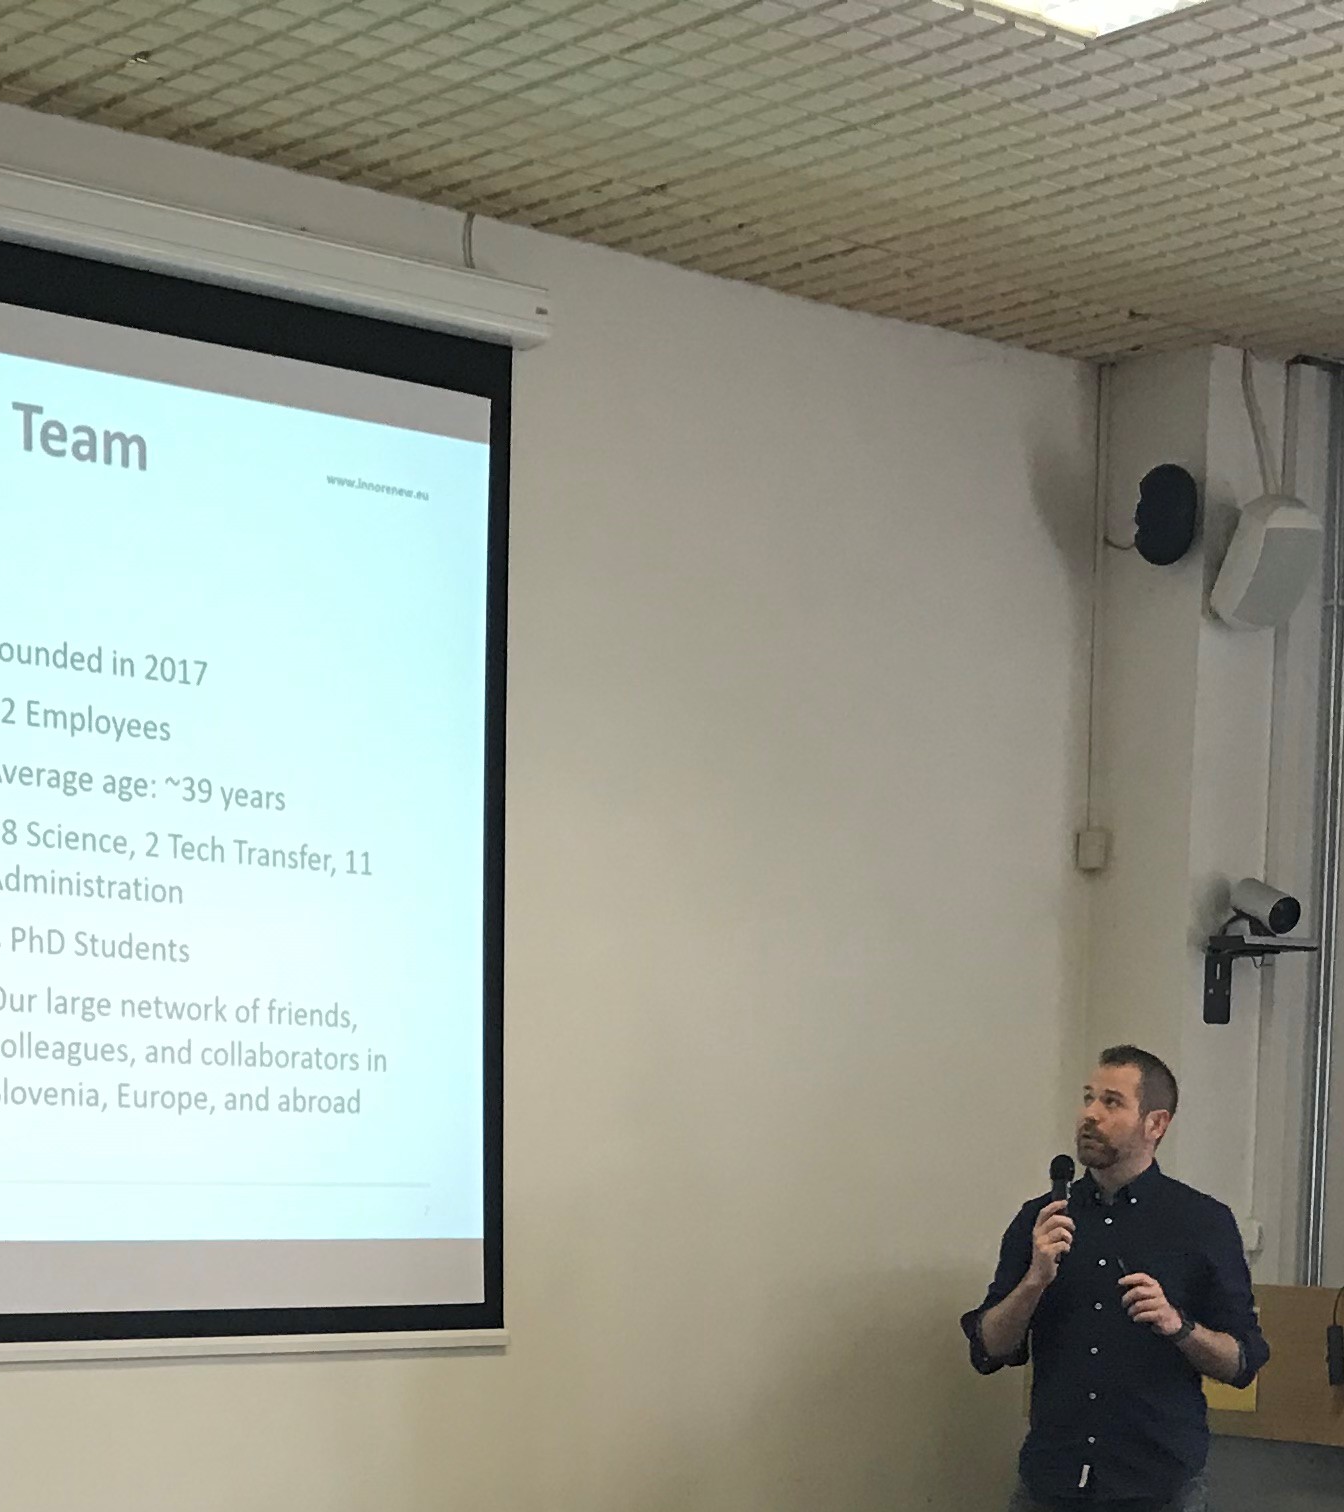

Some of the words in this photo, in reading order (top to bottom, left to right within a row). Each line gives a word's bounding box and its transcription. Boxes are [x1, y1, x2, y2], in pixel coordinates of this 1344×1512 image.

[12, 402, 149, 472] Team
[326, 473, 430, 502] www.innorenew.eu
[112, 649, 135, 678] in
[144, 654, 208, 686] 2017
[27, 700, 171, 743] Employees
[103, 774, 157, 802] age:
[165, 774, 213, 804] ~39
[221, 783, 286, 812] years
[27, 822, 136, 862] Science,
[145, 831, 159, 857] 2
[169, 834, 225, 864] Tech
[234, 839, 337, 878] Transfer,
[346, 850, 373, 877] 11
[11, 926, 65, 956] PhD
[74, 930, 190, 964] Students
[46, 989, 111, 1023] large
[121, 996, 227, 1024] network
[235, 997, 261, 1025] of
[267, 999, 358, 1033] friends,
[145, 1038, 192, 1066] and
[201, 1041, 359, 1072] collaborators
[367, 1049, 387, 1073] in
[118, 1082, 216, 1115] Europe,
[225, 1087, 270, 1113] and
[279, 1087, 361, 1115] abroad
